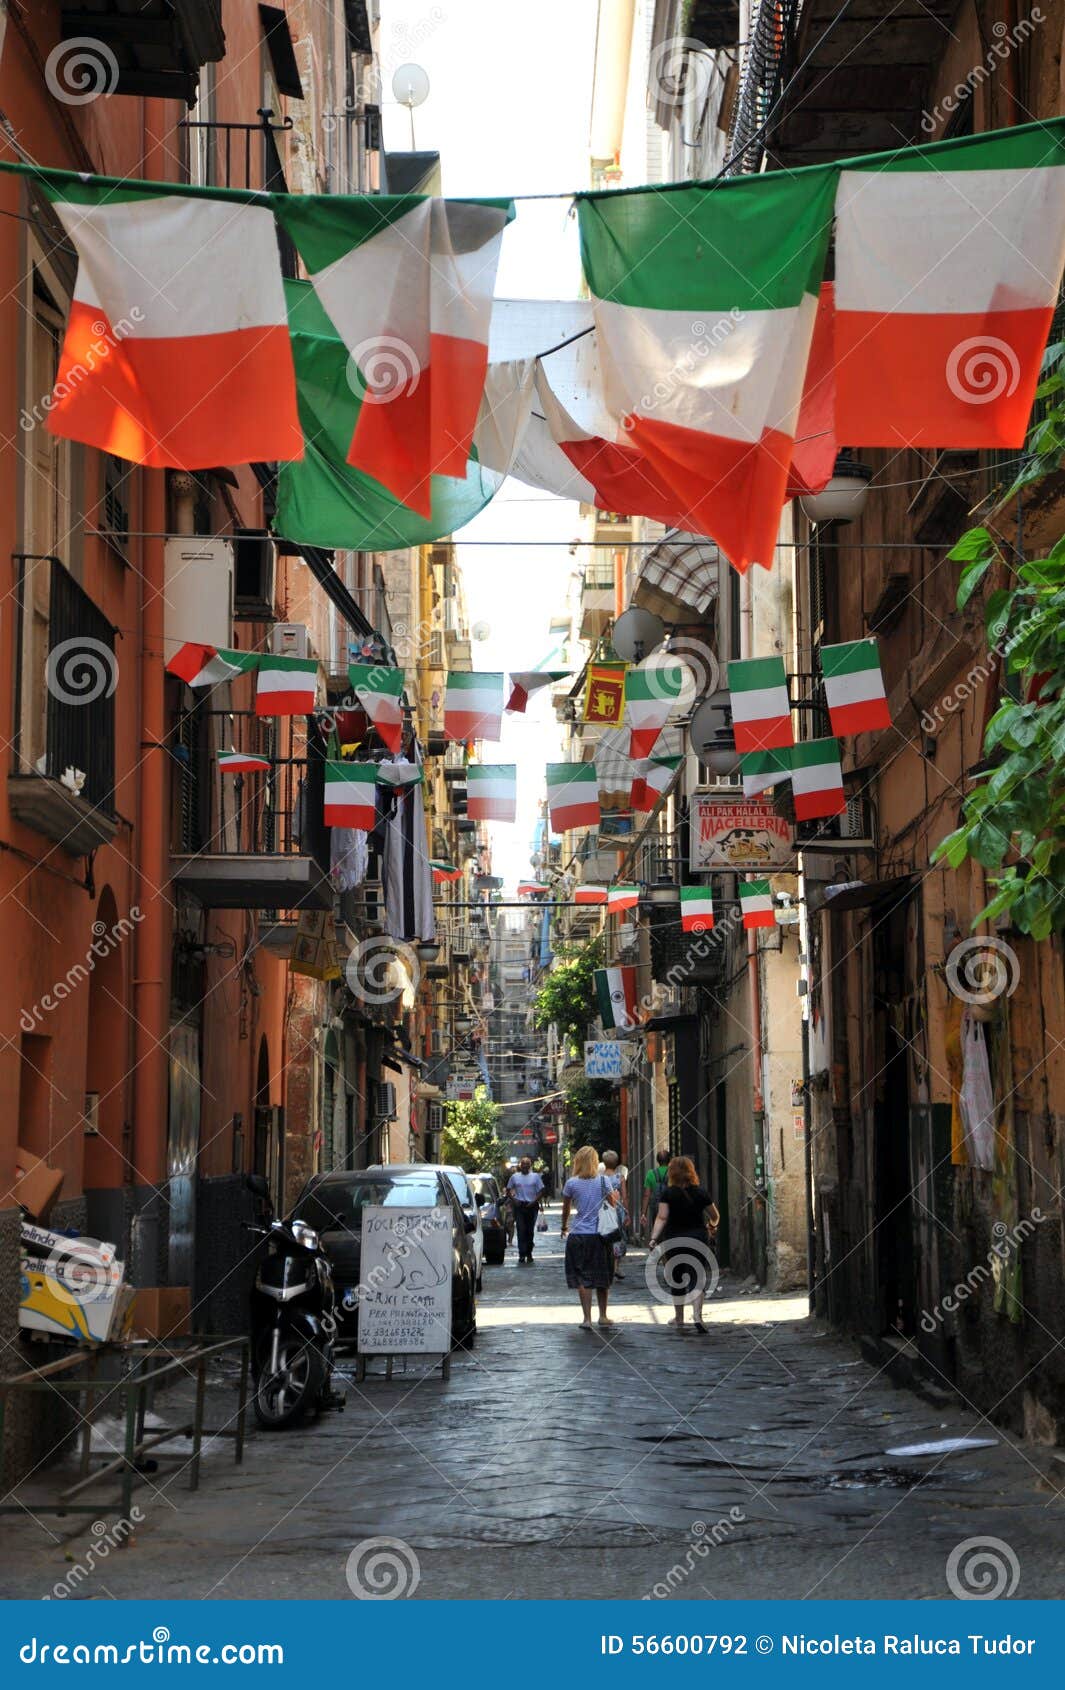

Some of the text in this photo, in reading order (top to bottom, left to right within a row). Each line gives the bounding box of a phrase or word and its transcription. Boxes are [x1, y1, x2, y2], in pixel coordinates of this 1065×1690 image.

[701, 806, 714, 817] ALI
[717, 806, 733, 817] PAK
[735, 806, 765, 817] HALAL
[700, 817, 791, 842] MACELLERIA
[368, 1308, 387, 1319] PER
